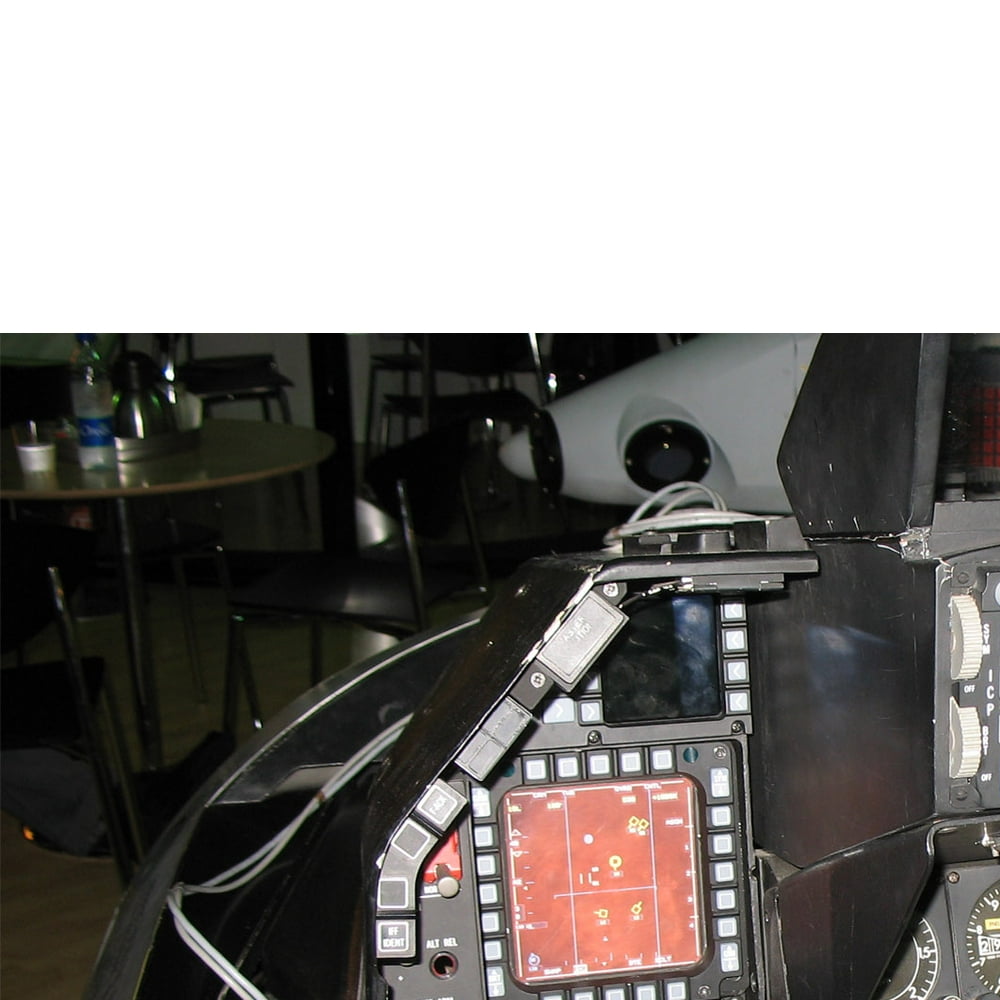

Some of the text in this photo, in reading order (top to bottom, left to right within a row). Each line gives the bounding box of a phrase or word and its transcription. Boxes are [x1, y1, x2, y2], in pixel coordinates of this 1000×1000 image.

[964, 685, 976, 694] OFF
[986, 668, 995, 717] ICP
[981, 773, 992, 782] OFF
[991, 899, 999, 911] 9
[388, 927, 399, 936] IFF
[383, 938, 405, 948] IDENT
[426, 937, 458, 949] ALT REL
